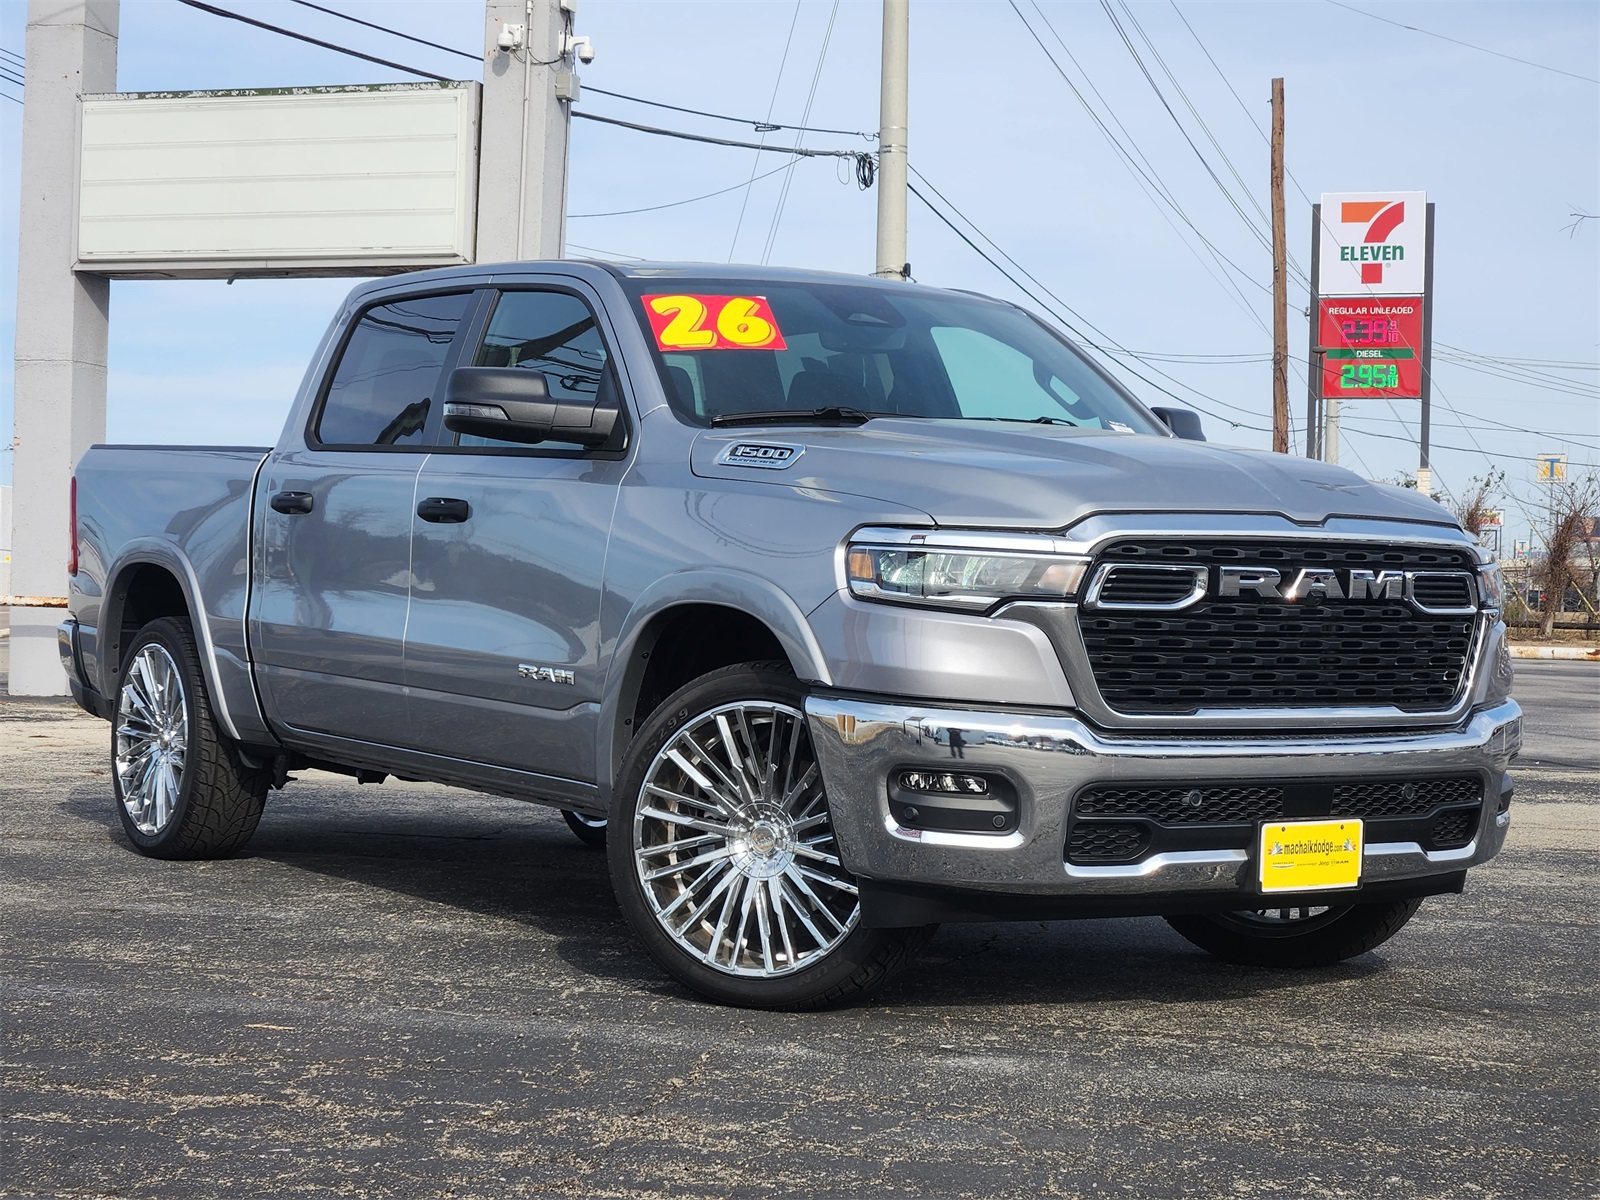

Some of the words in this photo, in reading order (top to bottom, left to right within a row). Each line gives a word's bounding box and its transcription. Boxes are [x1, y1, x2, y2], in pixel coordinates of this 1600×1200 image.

[1328, 307, 1368, 315] REGULAR
[1369, 306, 1414, 315] UNLEADED
[650, 295, 776, 347] 26
[1356, 350, 1384, 358] DIESEL
[735, 446, 791, 459] 1500
[1219, 566, 1404, 600] RAM
[518, 663, 575, 686] RAM
